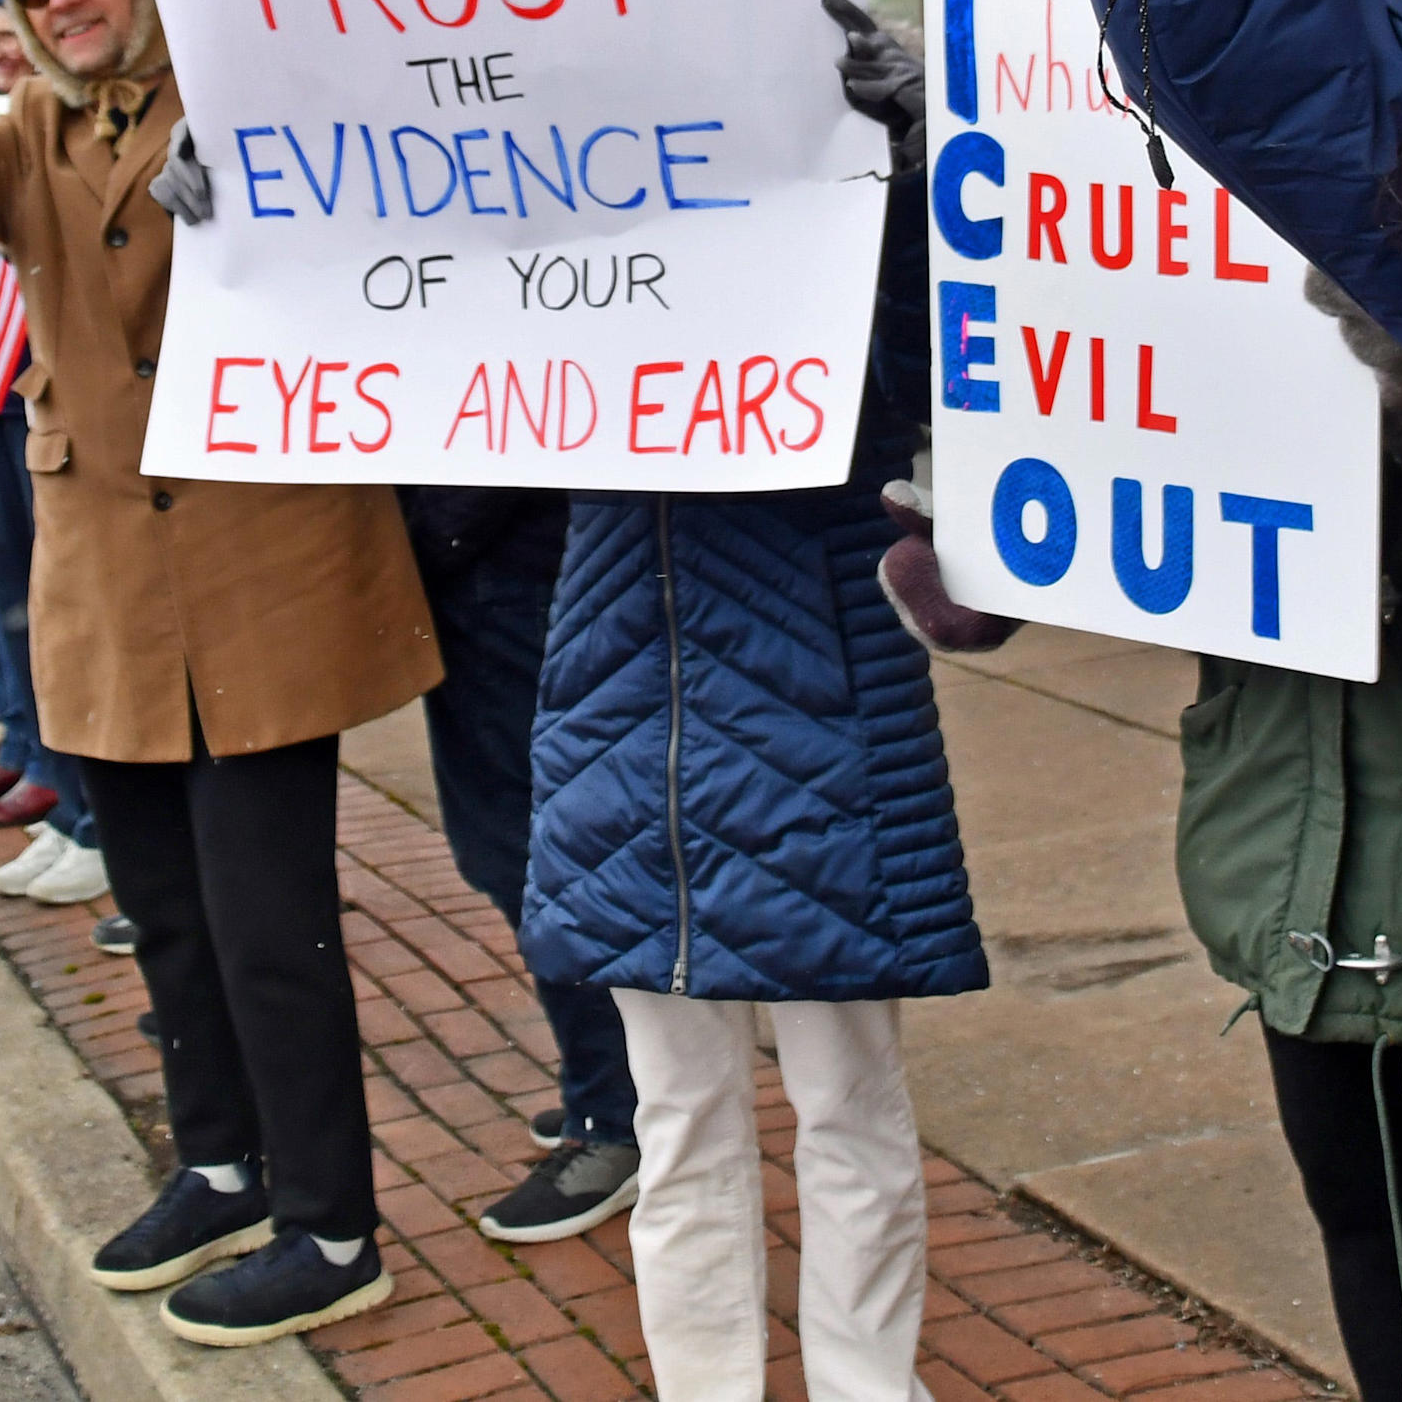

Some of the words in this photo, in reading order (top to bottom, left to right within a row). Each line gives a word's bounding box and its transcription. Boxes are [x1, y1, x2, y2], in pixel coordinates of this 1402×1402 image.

[406, 51, 525, 109] THE
[234, 120, 751, 221] EVIDENCE
[362, 253, 455, 311] OF
[507, 252, 670, 311] YOUR
[205, 354, 401, 455] EYES
[443, 358, 598, 456] AND
[627, 354, 830, 456] EARS
[992, 457, 1314, 641] OUT
